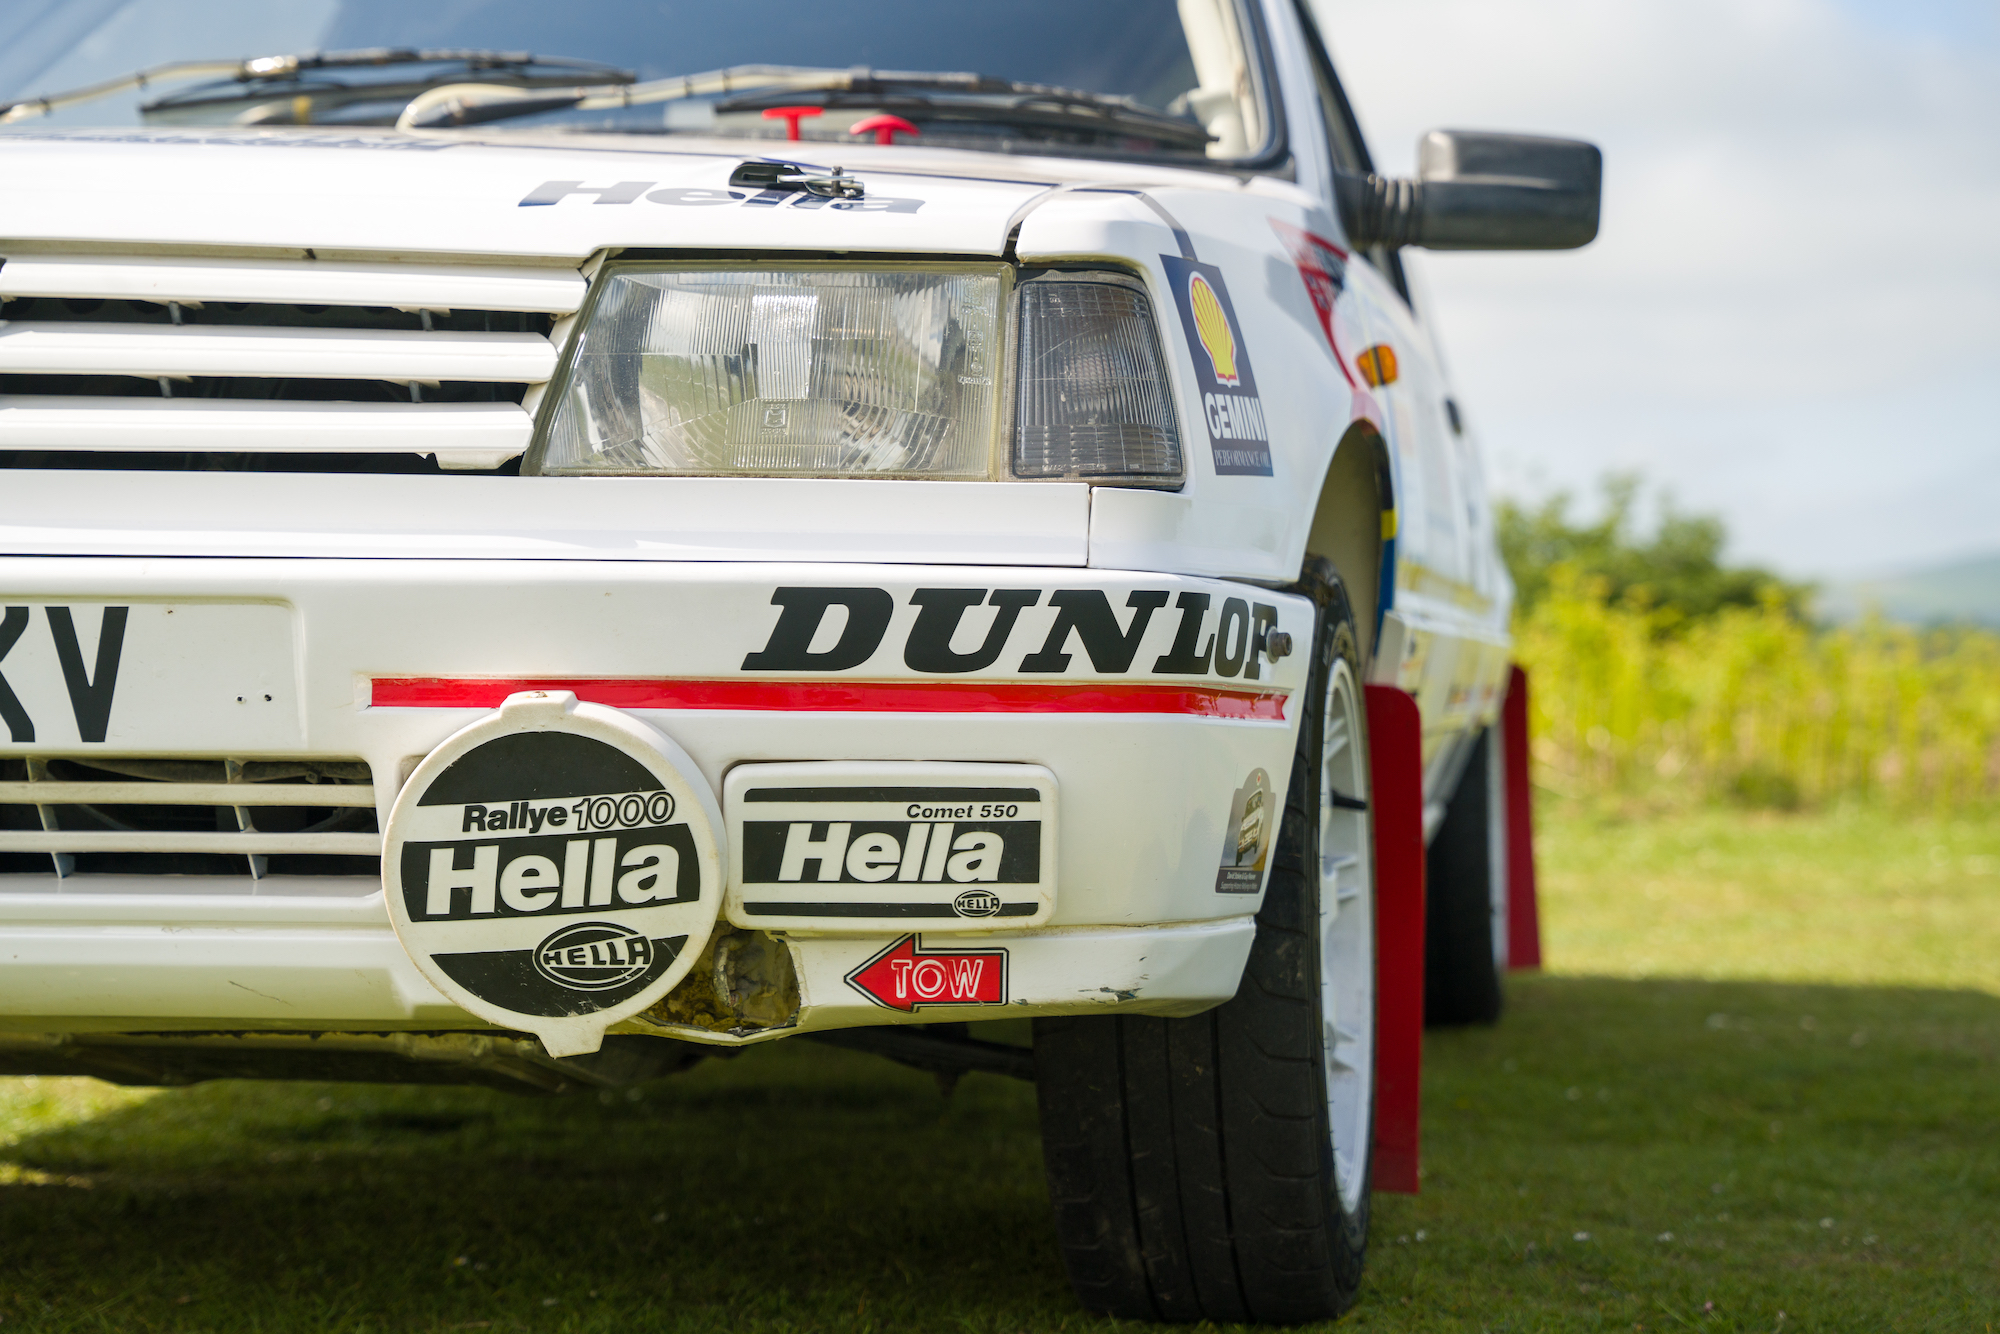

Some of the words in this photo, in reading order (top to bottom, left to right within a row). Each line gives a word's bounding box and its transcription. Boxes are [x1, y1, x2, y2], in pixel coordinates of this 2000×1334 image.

[1204, 393, 1267, 441] GEMINI
[742, 587, 1278, 680] DUNLOP
[462, 803, 567, 833] Rallye
[572, 792, 675, 830] 1000
[906, 804, 973, 818] Comet
[980, 804, 1018, 818] 550
[777, 823, 1004, 883] Hella
[426, 838, 680, 915] Hella
[956, 897, 1000, 910] HELLA
[542, 935, 651, 968] HELLA
[891, 958, 983, 999] TOW
